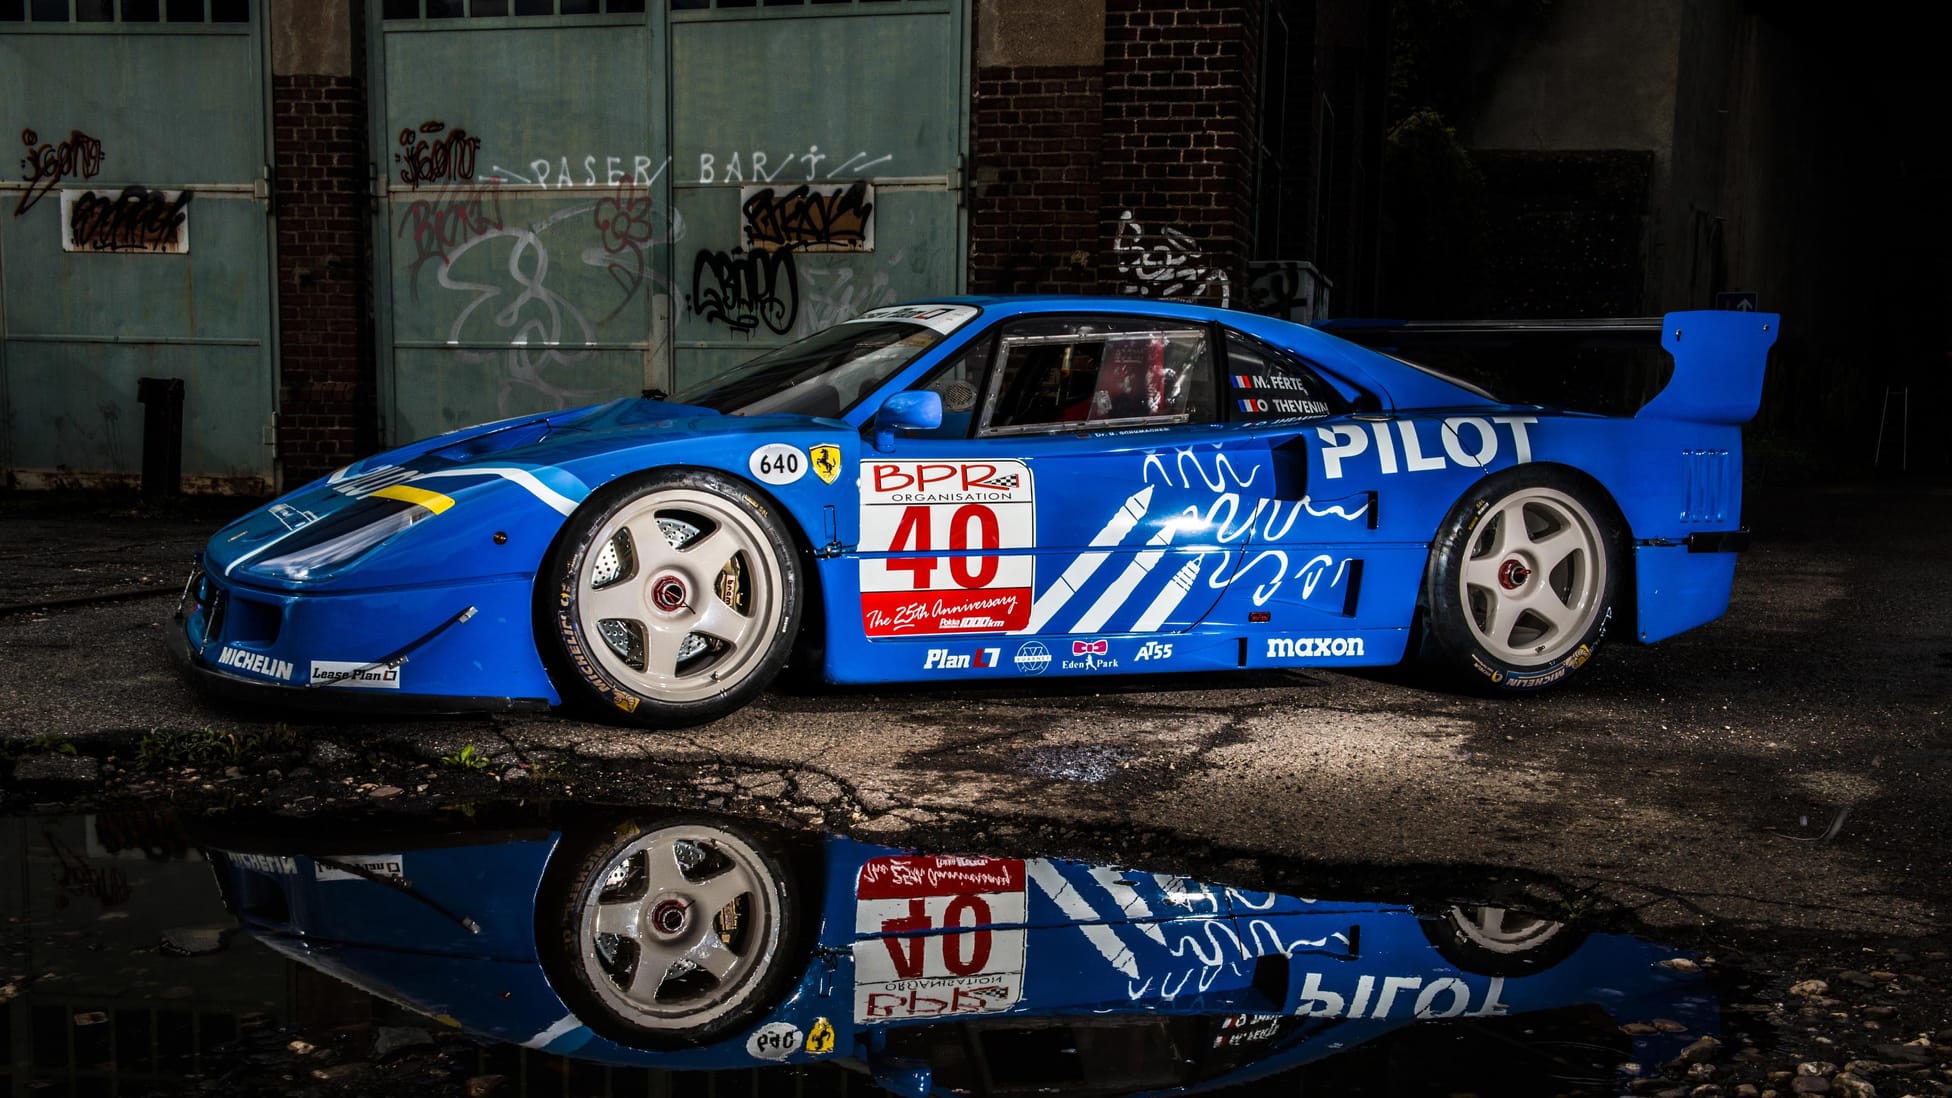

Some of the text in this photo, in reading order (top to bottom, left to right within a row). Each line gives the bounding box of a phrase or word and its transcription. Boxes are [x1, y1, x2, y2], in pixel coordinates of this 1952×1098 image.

[530, 155, 664, 189] PASER
[700, 151, 780, 184] BAR
[1252, 375, 1271, 389] M.
[1272, 399, 1330, 415] THEVENIN
[1316, 416, 1539, 480] PILOT
[760, 453, 798, 474] 640
[873, 464, 1010, 492] BPR
[892, 492, 1012, 502] ORGANISATION
[886, 503, 1000, 589] 40
[866, 595, 1018, 629] The 25th Anniversary
[1134, 641, 1173, 662] AT55
[1266, 637, 1365, 658] maxon
[218, 646, 294, 681] MICHELIN
[923, 648, 970, 670] Plan
[1062, 659, 1119, 670] Eden Park
[311, 667, 381, 681] Lease Plan
[1505, 668, 1566, 687] MICHELIN
